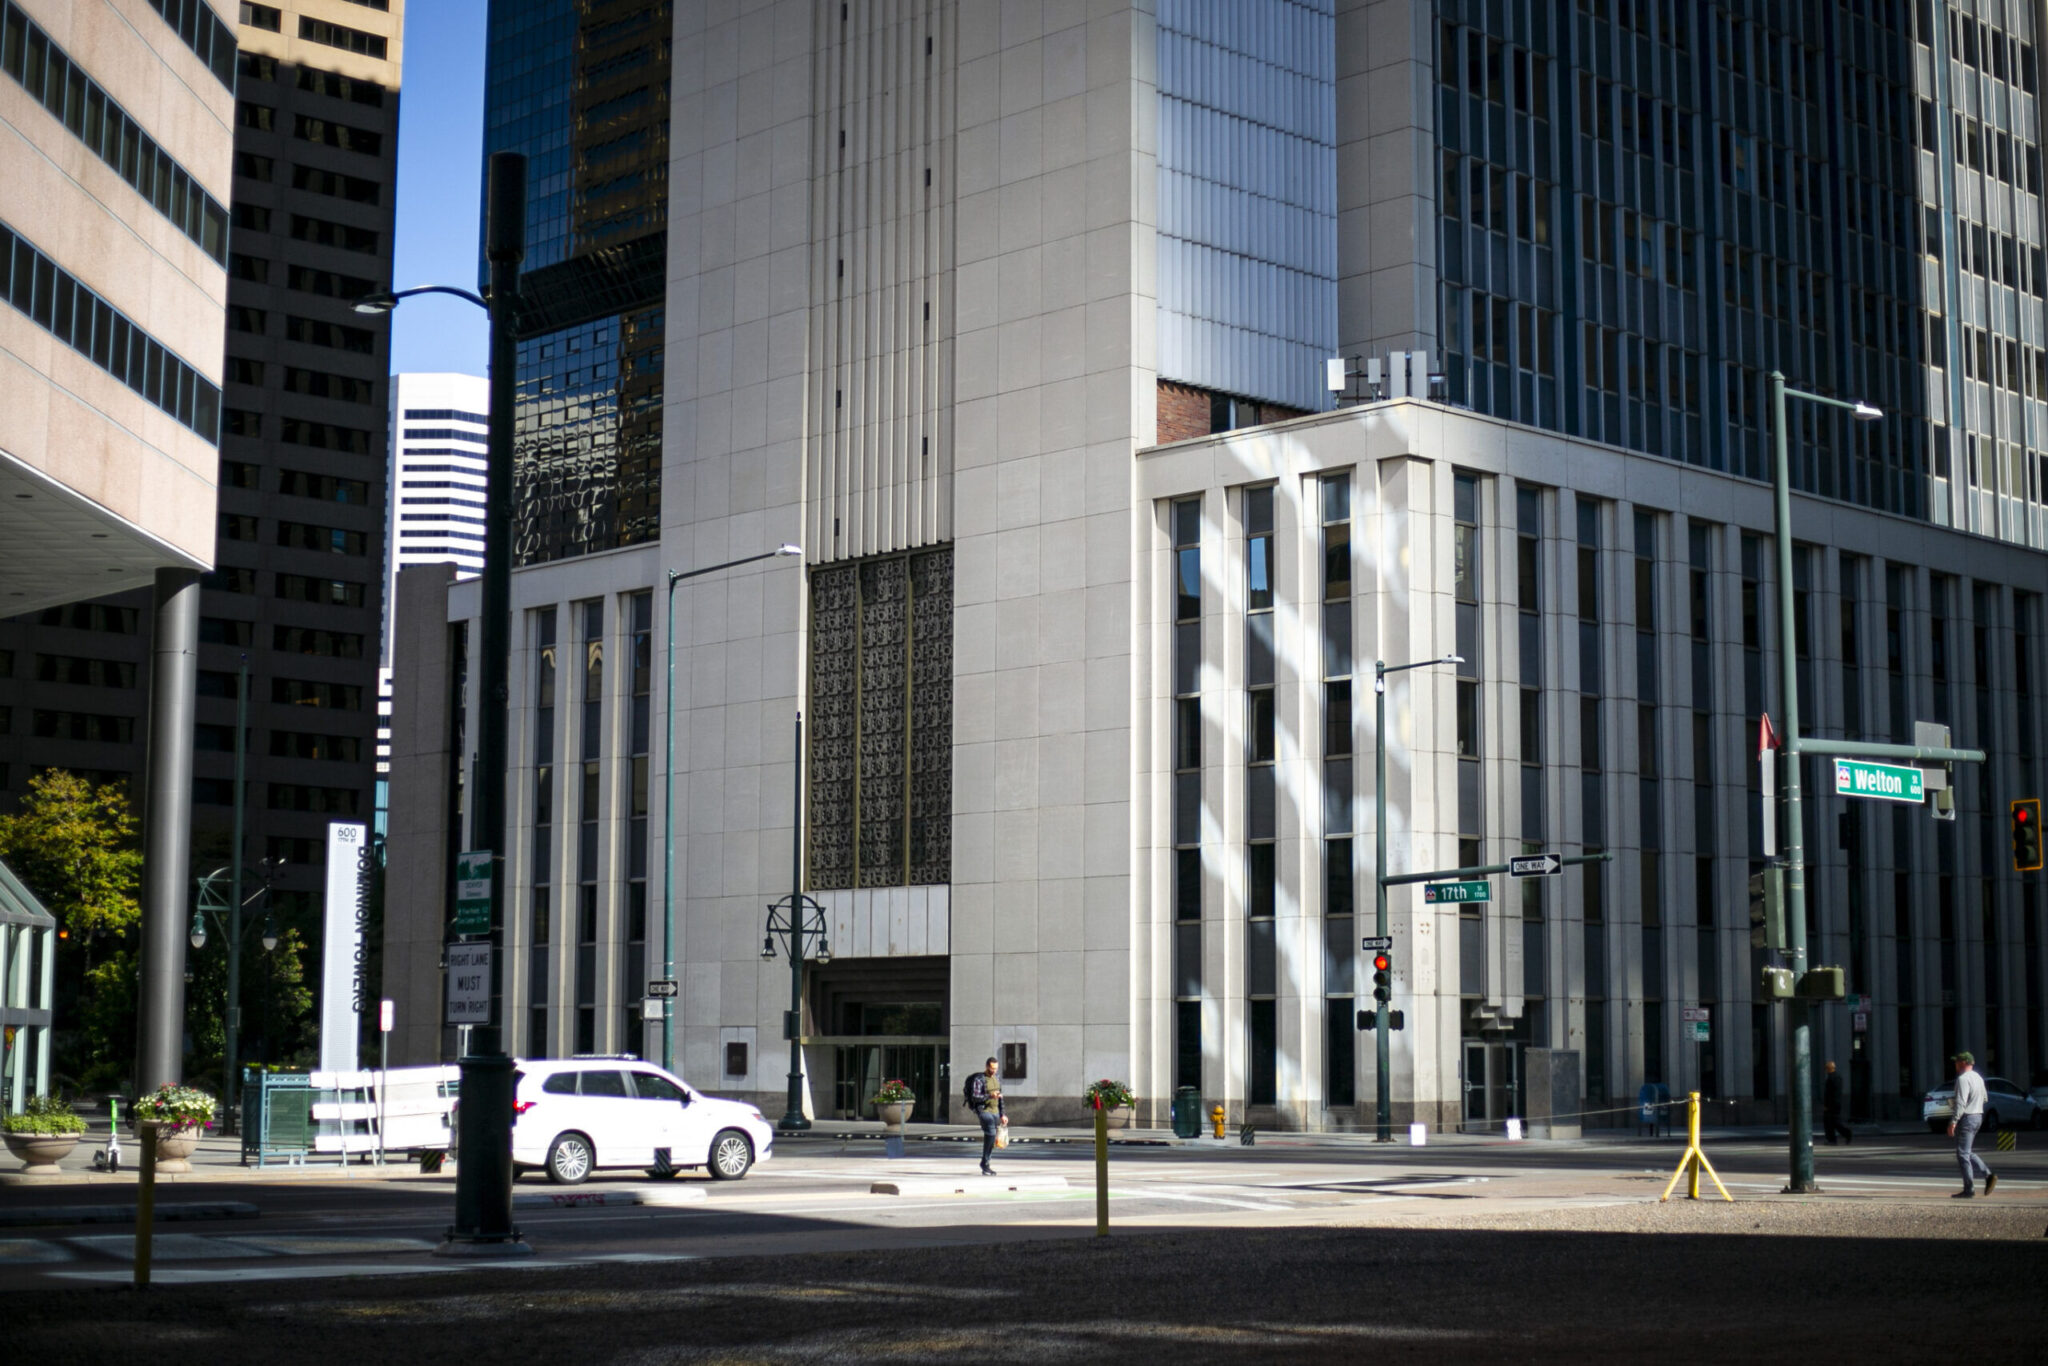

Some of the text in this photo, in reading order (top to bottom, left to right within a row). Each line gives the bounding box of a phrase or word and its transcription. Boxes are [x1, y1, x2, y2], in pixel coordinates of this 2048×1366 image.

[1854, 769, 1902, 794] Welton
[338, 827, 357, 838] 600
[1515, 861, 1545, 870] ONE WAY
[1441, 885, 1467, 900] 17th
[352, 846, 371, 1013] DOMINION TOWERS
[450, 953, 489, 966] RIGHT LANE
[457, 976, 481, 991] MUST
[449, 1001, 488, 1013] TURN RIGHT
